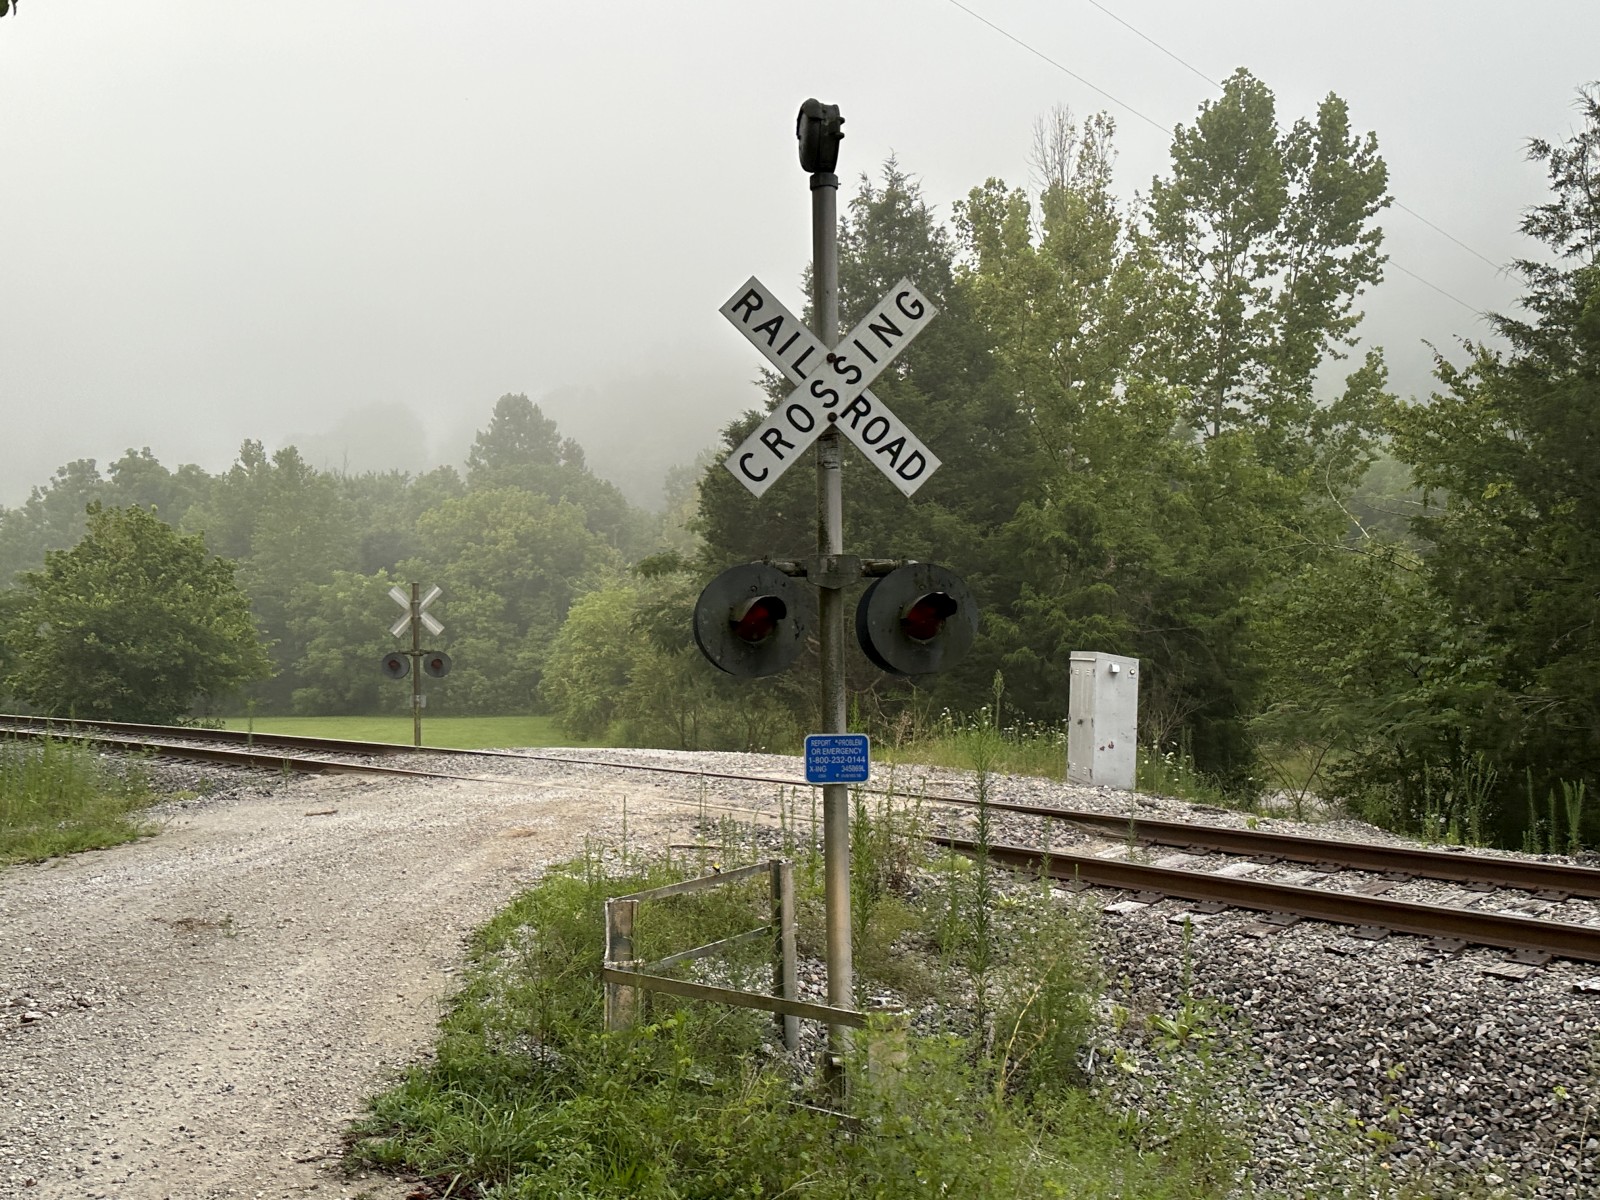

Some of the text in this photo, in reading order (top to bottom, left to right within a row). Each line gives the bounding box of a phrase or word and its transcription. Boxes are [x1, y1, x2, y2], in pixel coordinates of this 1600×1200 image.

[731, 288, 926, 481] RAIL ROAD
[739, 291, 925, 482] CROSSING
[808, 756, 866, 764] 1-800-232-0144
